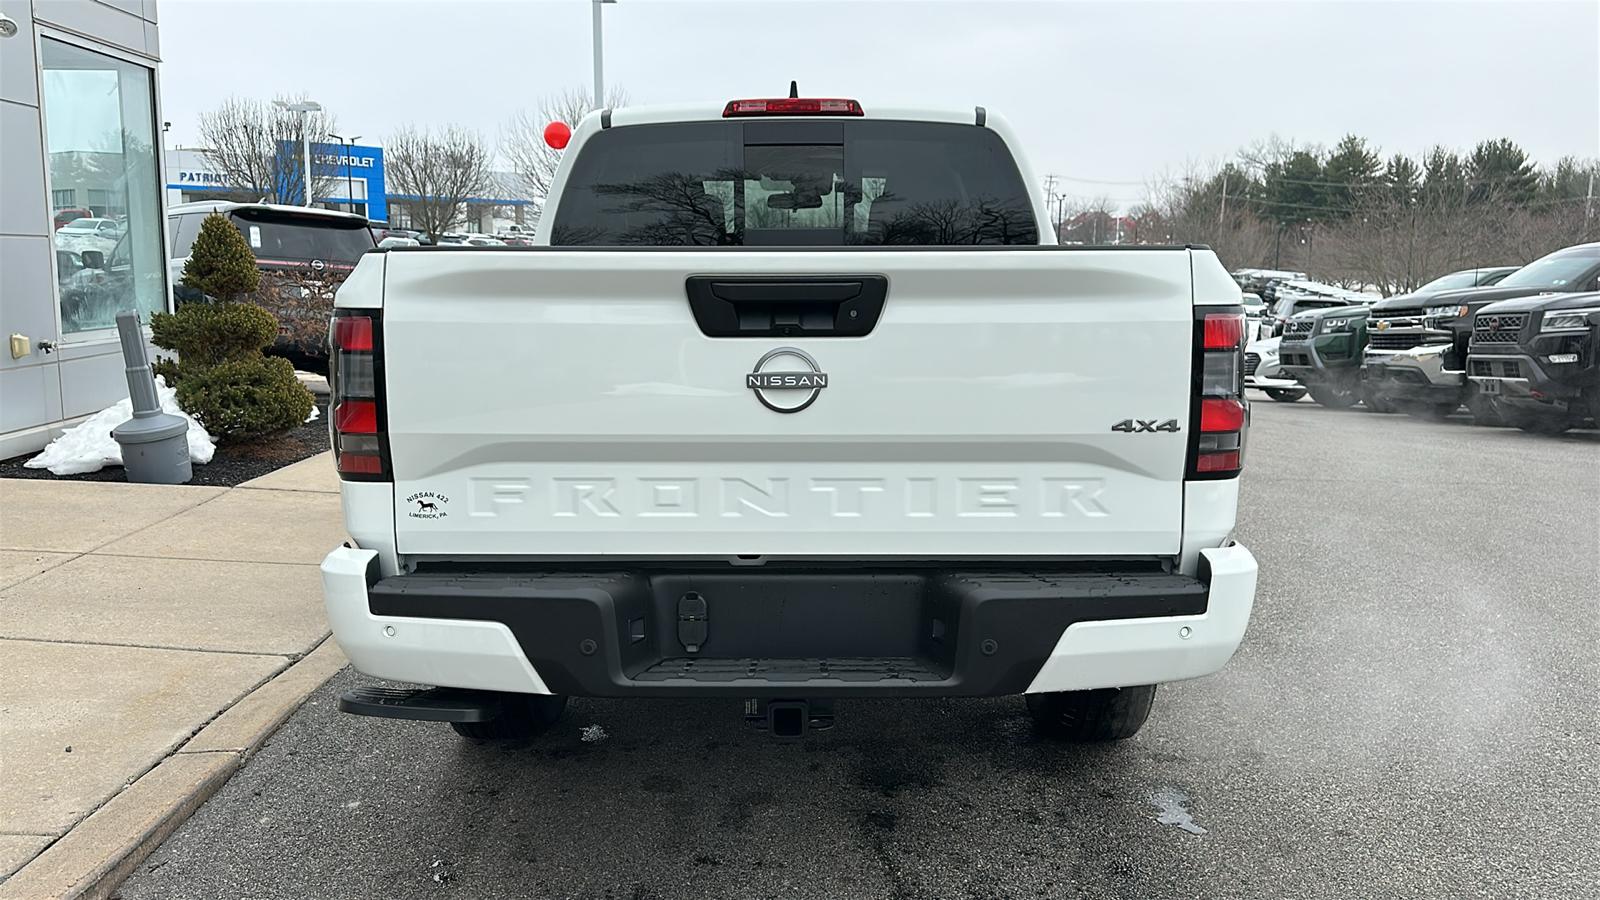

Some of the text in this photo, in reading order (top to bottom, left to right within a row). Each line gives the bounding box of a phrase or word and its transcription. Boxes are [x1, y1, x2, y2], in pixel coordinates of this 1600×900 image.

[180, 172, 228, 183] PATRIOT
[748, 375, 826, 386] NISSAN
[406, 491, 449, 504] NISSAN 422
[467, 476, 1110, 518] FRONTIER
